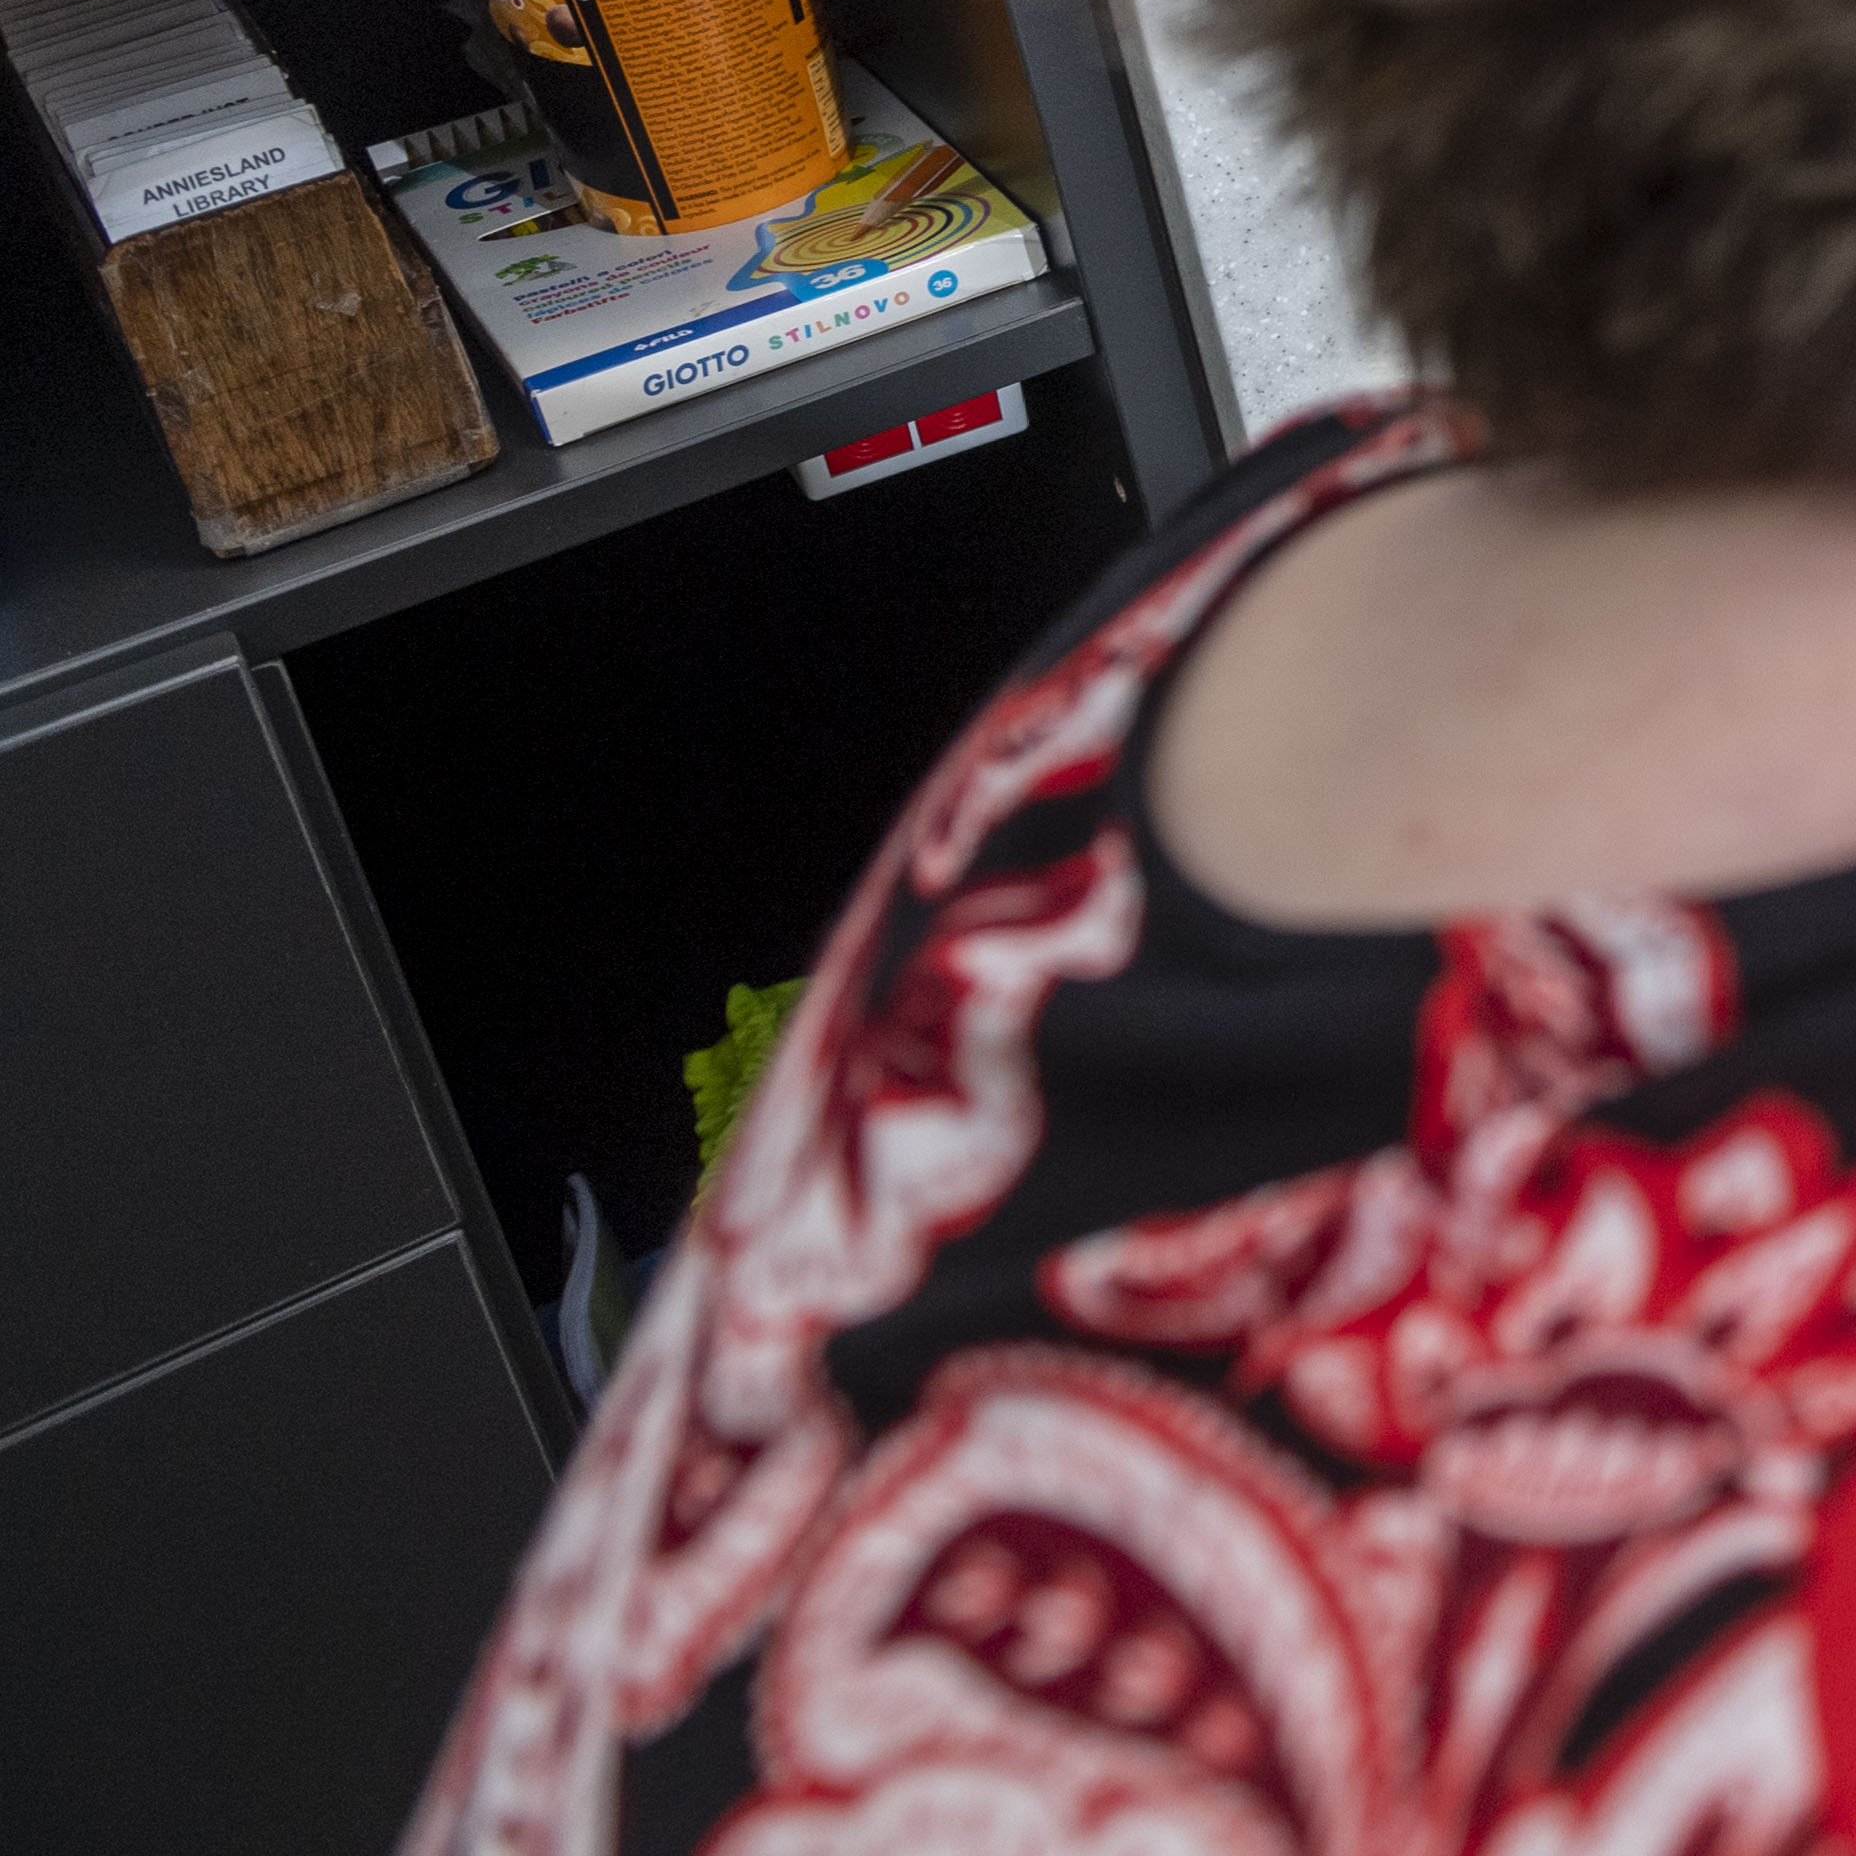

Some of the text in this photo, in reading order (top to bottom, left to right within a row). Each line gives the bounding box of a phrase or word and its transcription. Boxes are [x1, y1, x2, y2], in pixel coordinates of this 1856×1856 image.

[142, 147, 286, 205] ANNIESLAND
[173, 174, 270, 218] LIBRARY
[513, 275, 590, 301] pastelli
[614, 249, 673, 272] colori
[518, 244, 711, 306] crayons de couleur
[522, 258, 692, 312] coloured pencils
[608, 284, 633, 295] de
[639, 258, 714, 285] colores
[809, 263, 868, 290] 36
[931, 277, 953, 292] 36
[530, 292, 630, 325] Farbstifte
[643, 291, 910, 396] GIOTTO STILNOVO
